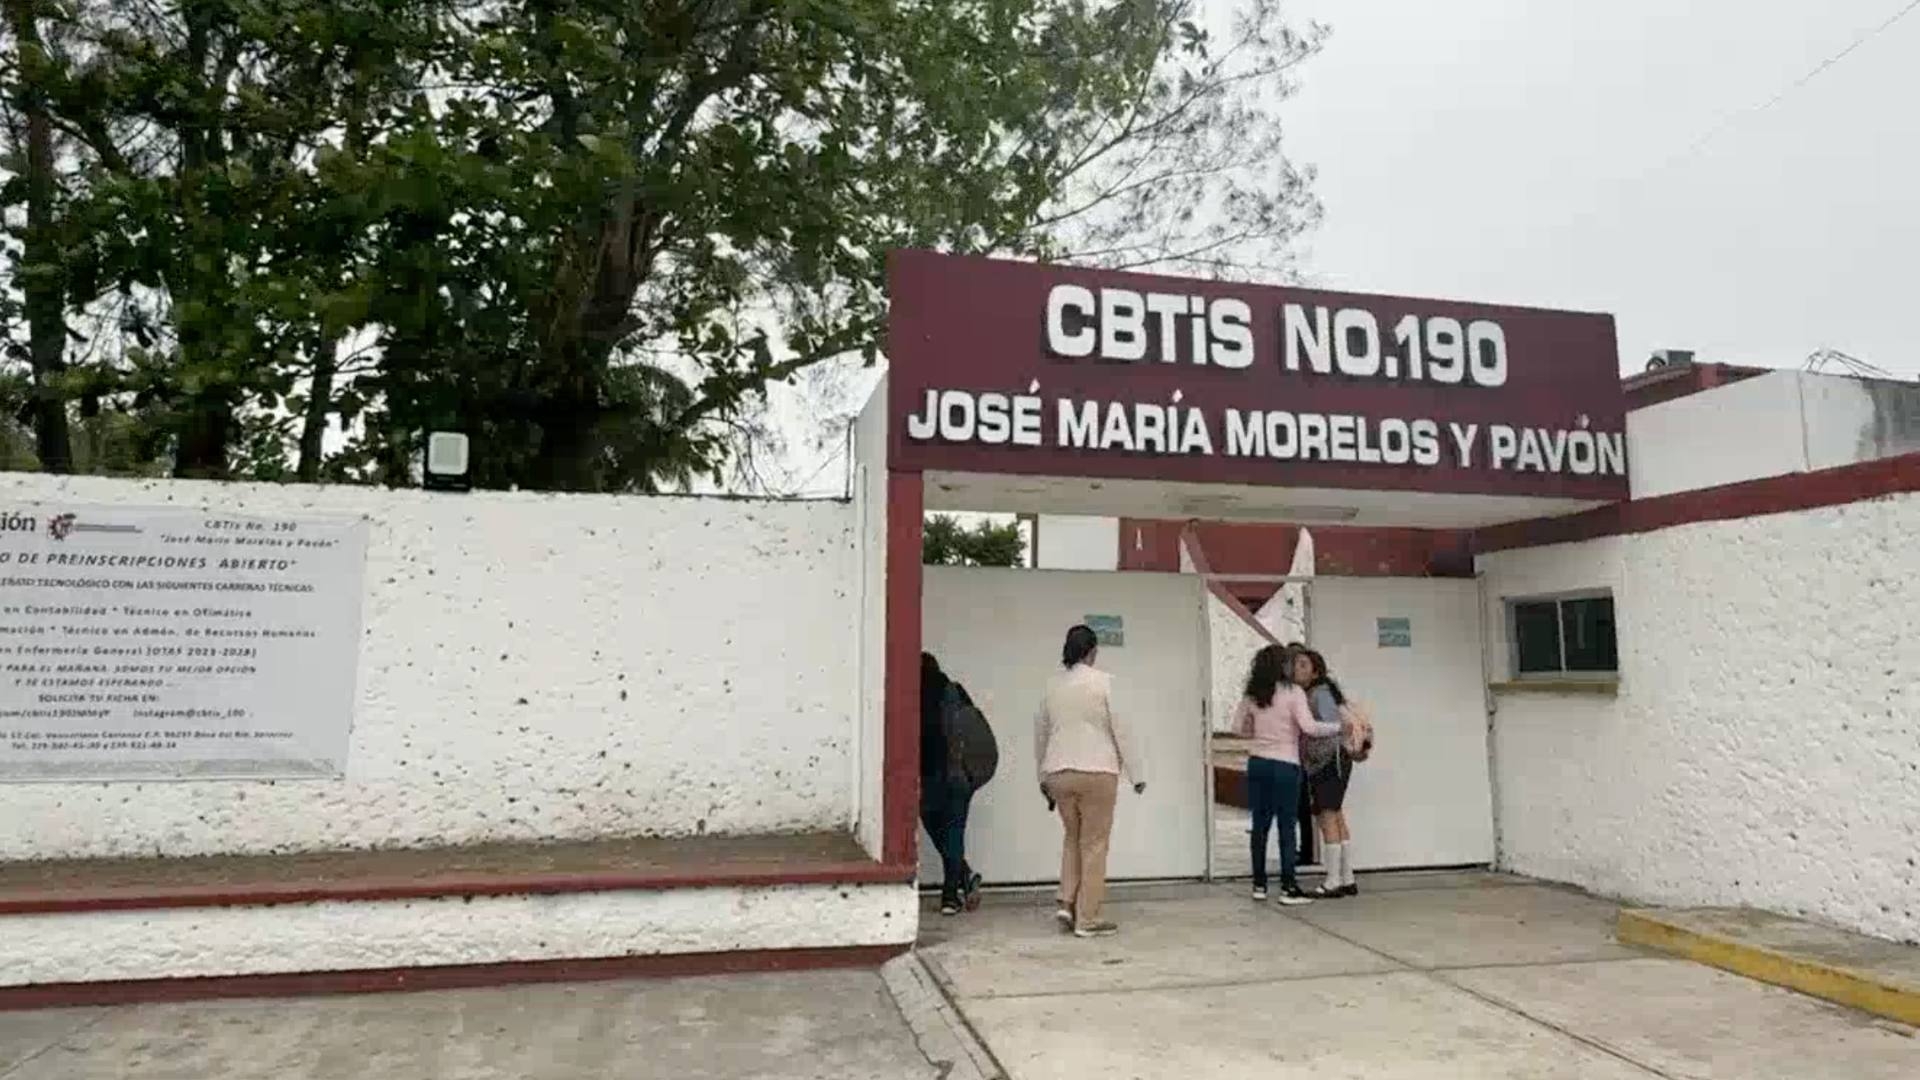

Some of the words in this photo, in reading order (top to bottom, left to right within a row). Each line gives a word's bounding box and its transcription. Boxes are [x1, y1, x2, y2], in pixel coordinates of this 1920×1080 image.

[1284, 303, 1508, 387] NO.190
[908, 379, 1042, 446] JOSÉ
[1057, 388, 1212, 455] MARÍA
[1225, 408, 1440, 466] MORELOS
[1450, 422, 1478, 469] Y
[1491, 413, 1626, 476] PAVÓN
[18, 553, 39, 565] DE
[46, 553, 207, 569] PREINSCRIPCIONES
[37, 577, 110, 590] TECNOLÓGICO
[112, 579, 134, 591] CON
[136, 580, 154, 591] LAS
[156, 580, 213, 593] SIGUIENTES
[215, 582, 267, 592] CARRERAS
[25, 605, 107, 616] Contabilidad
[173, 608, 190, 618] en
[204, 628, 258, 638] Recursos
[261, 629, 316, 639] Humanos
[93, 646, 142, 657] General
